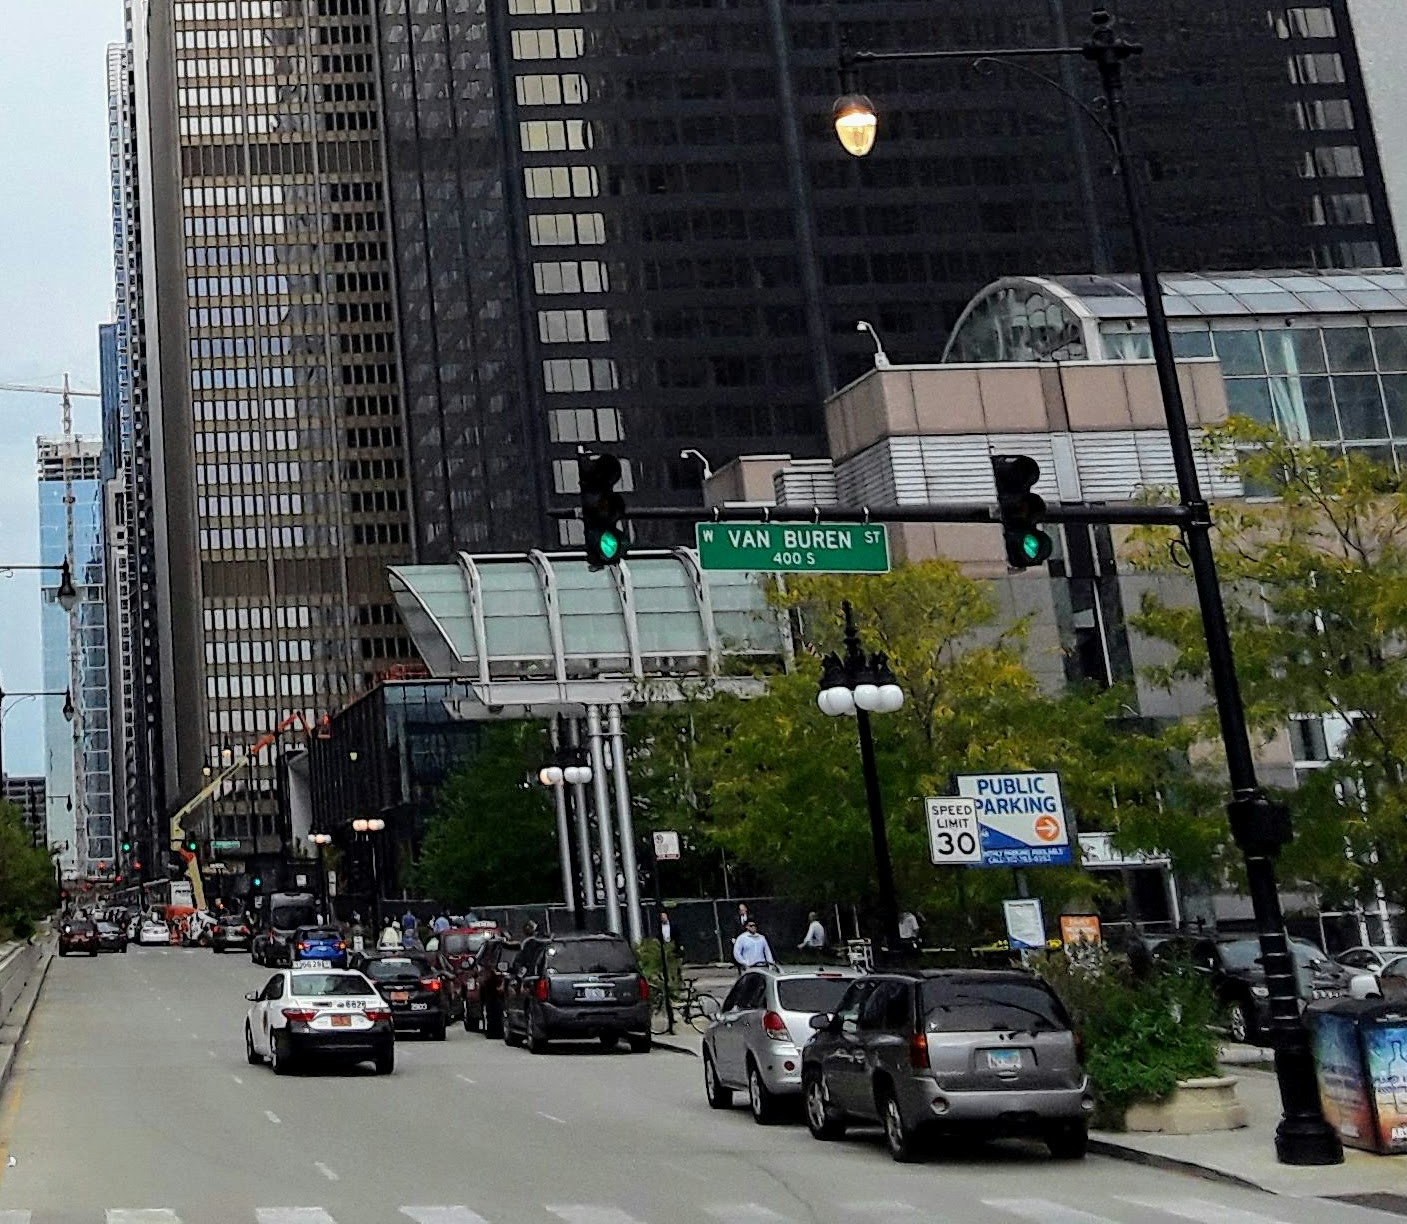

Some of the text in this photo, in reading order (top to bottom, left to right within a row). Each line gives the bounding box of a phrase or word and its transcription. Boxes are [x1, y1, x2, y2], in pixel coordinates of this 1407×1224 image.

[702, 529, 881, 549] W VAN BUREN ST
[773, 552, 816, 565] 400 S
[976, 777, 1046, 795] PUBLIC
[931, 805, 973, 816] SPEED
[975, 796, 1057, 815] PARKING
[936, 818, 970, 829] LIMIT
[937, 831, 976, 855] 30
